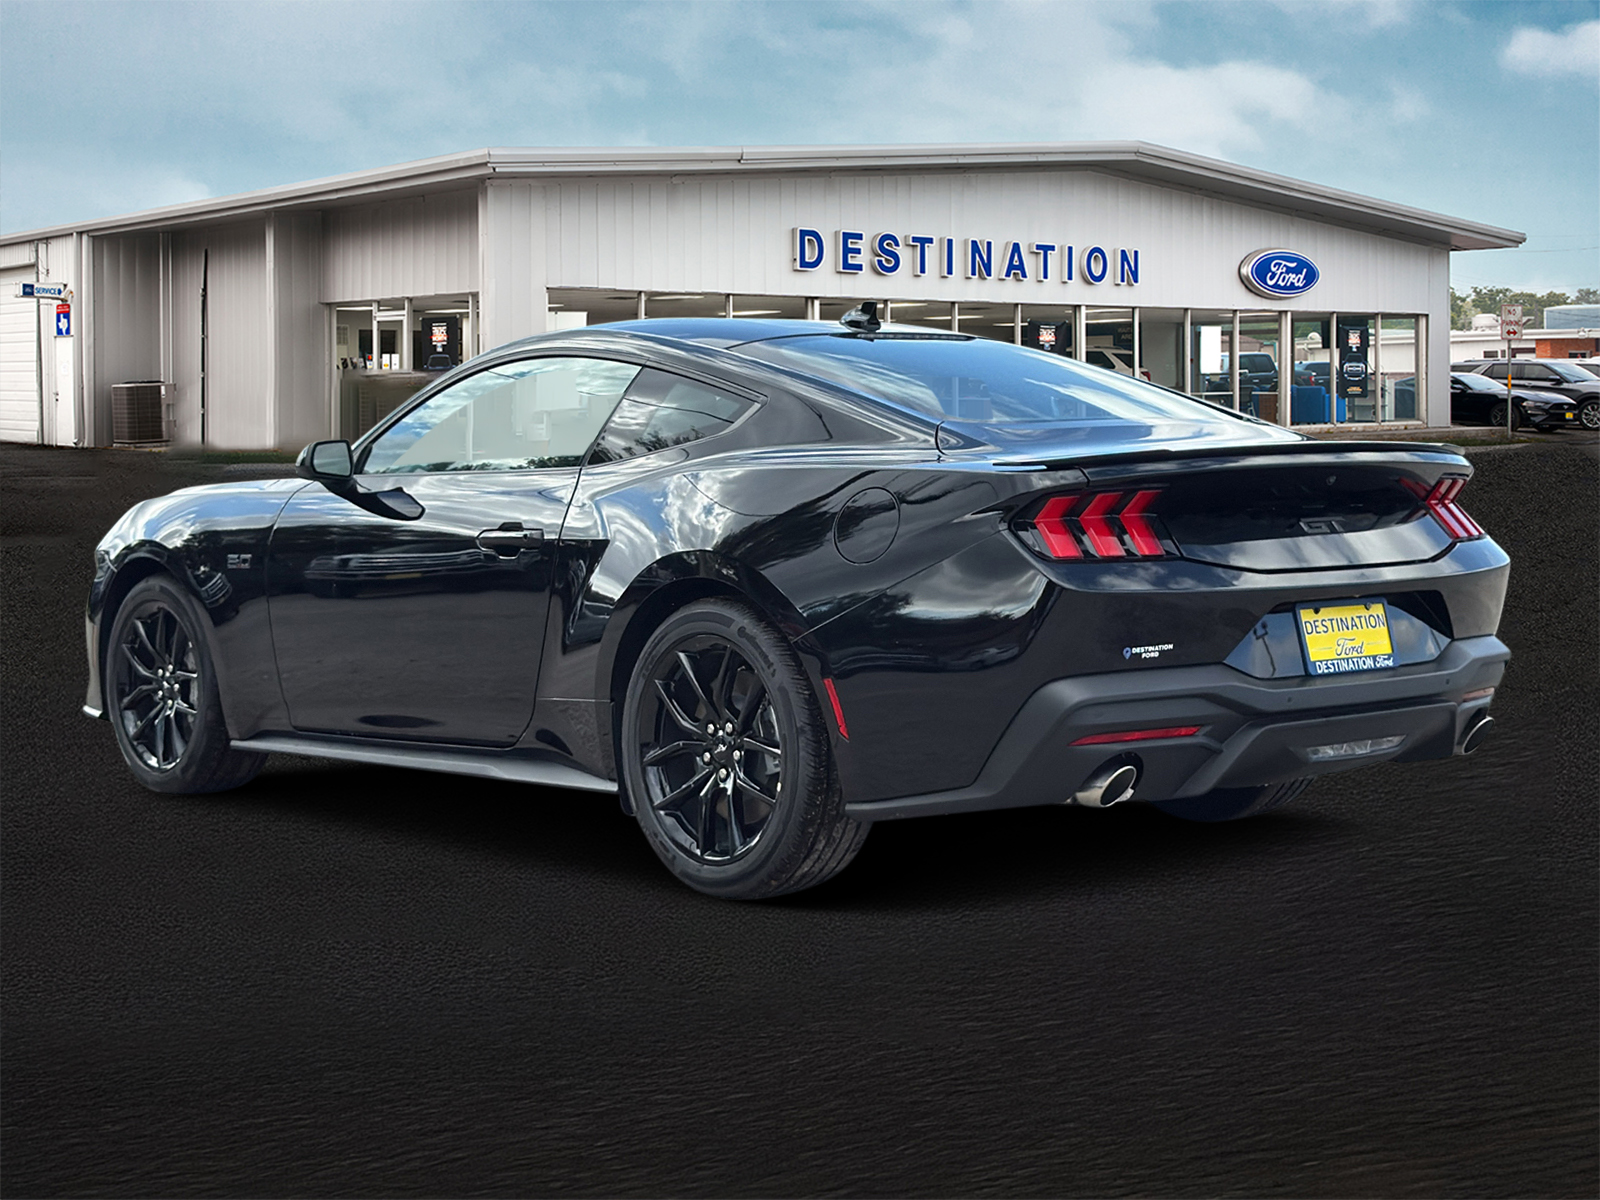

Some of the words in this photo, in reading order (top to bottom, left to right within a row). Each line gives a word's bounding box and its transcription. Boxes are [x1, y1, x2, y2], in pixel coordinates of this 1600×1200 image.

[795, 227, 1140, 286] DESTINATION
[1266, 259, 1307, 287] Ford
[35, 286, 58, 296] SERVICE
[1507, 308, 1517, 316] NO
[1299, 517, 1346, 534] GT
[1303, 613, 1386, 635] DESTINATION
[1131, 643, 1174, 654] DESTINATION
[1141, 651, 1160, 659] FORD
[1335, 637, 1365, 657] Ford
[1315, 656, 1375, 674] DESTINATION
[1375, 655, 1394, 668] Ford
